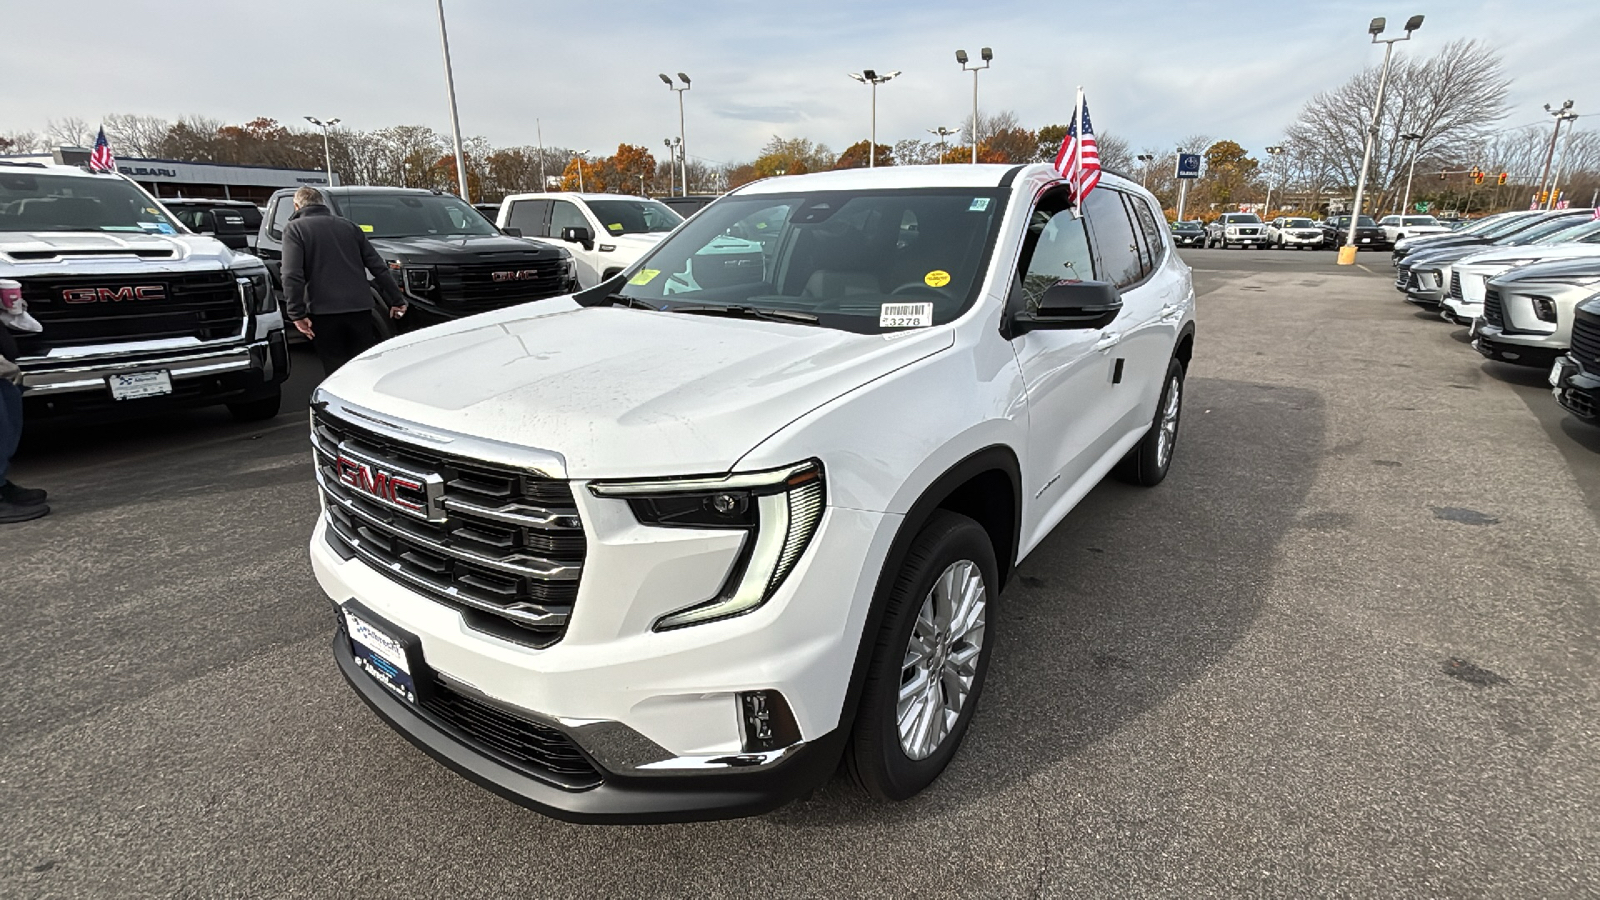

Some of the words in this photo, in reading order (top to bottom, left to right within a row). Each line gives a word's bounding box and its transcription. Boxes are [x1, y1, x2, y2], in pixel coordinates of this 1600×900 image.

[491, 270, 538, 282] GMC
[62, 286, 165, 303] GMC
[889, 318, 920, 326] 3278
[337, 455, 424, 512] GMC
